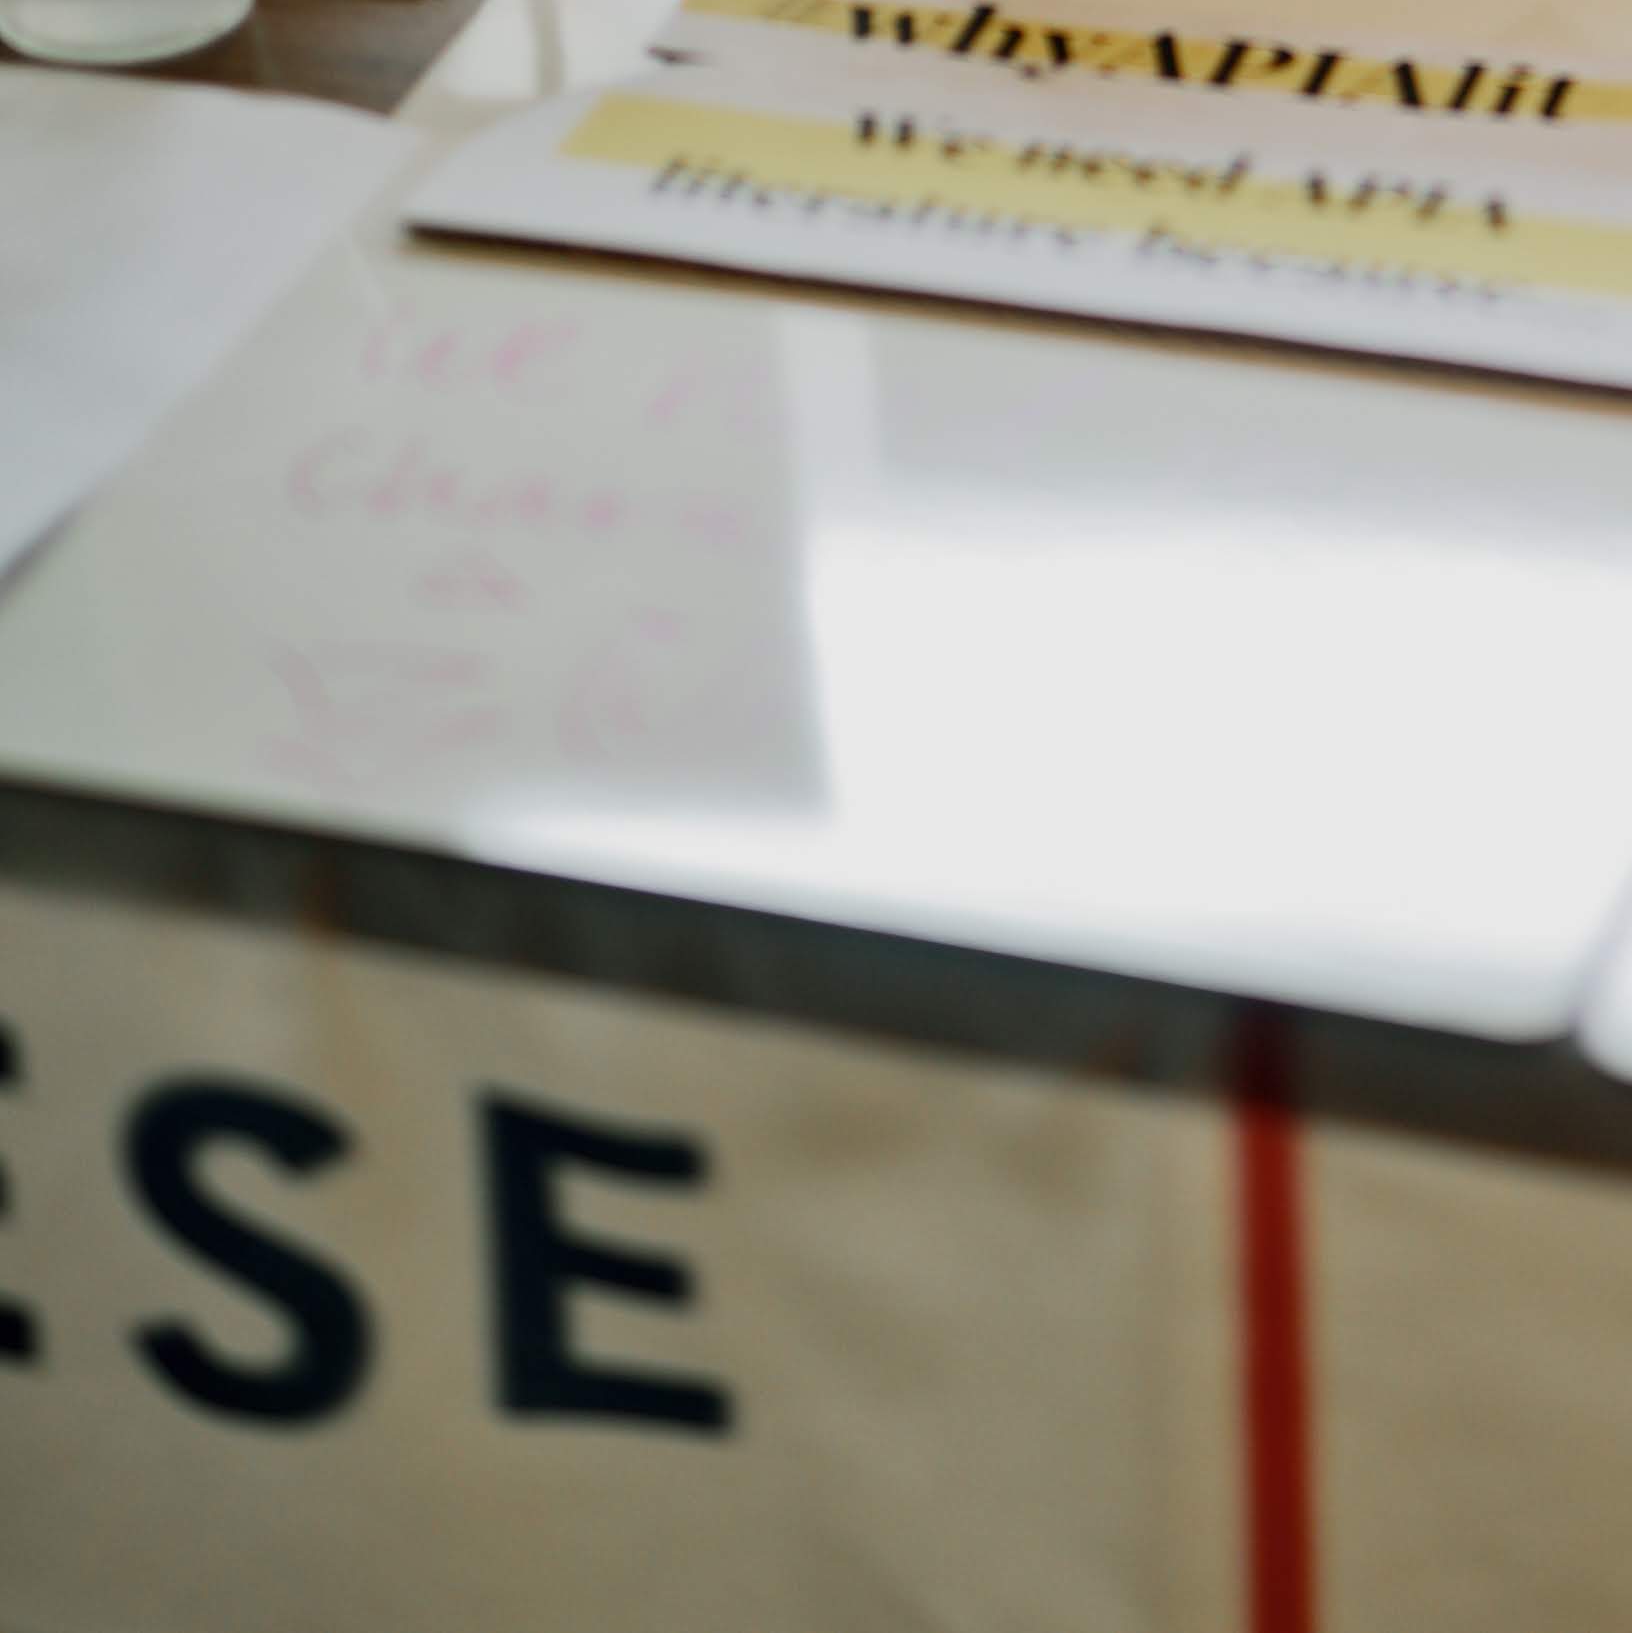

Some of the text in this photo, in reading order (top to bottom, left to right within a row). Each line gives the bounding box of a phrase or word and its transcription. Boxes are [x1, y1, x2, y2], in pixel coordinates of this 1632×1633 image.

[648, 153, 1080, 249] literature
[850, 111, 1516, 236] We need APIA
